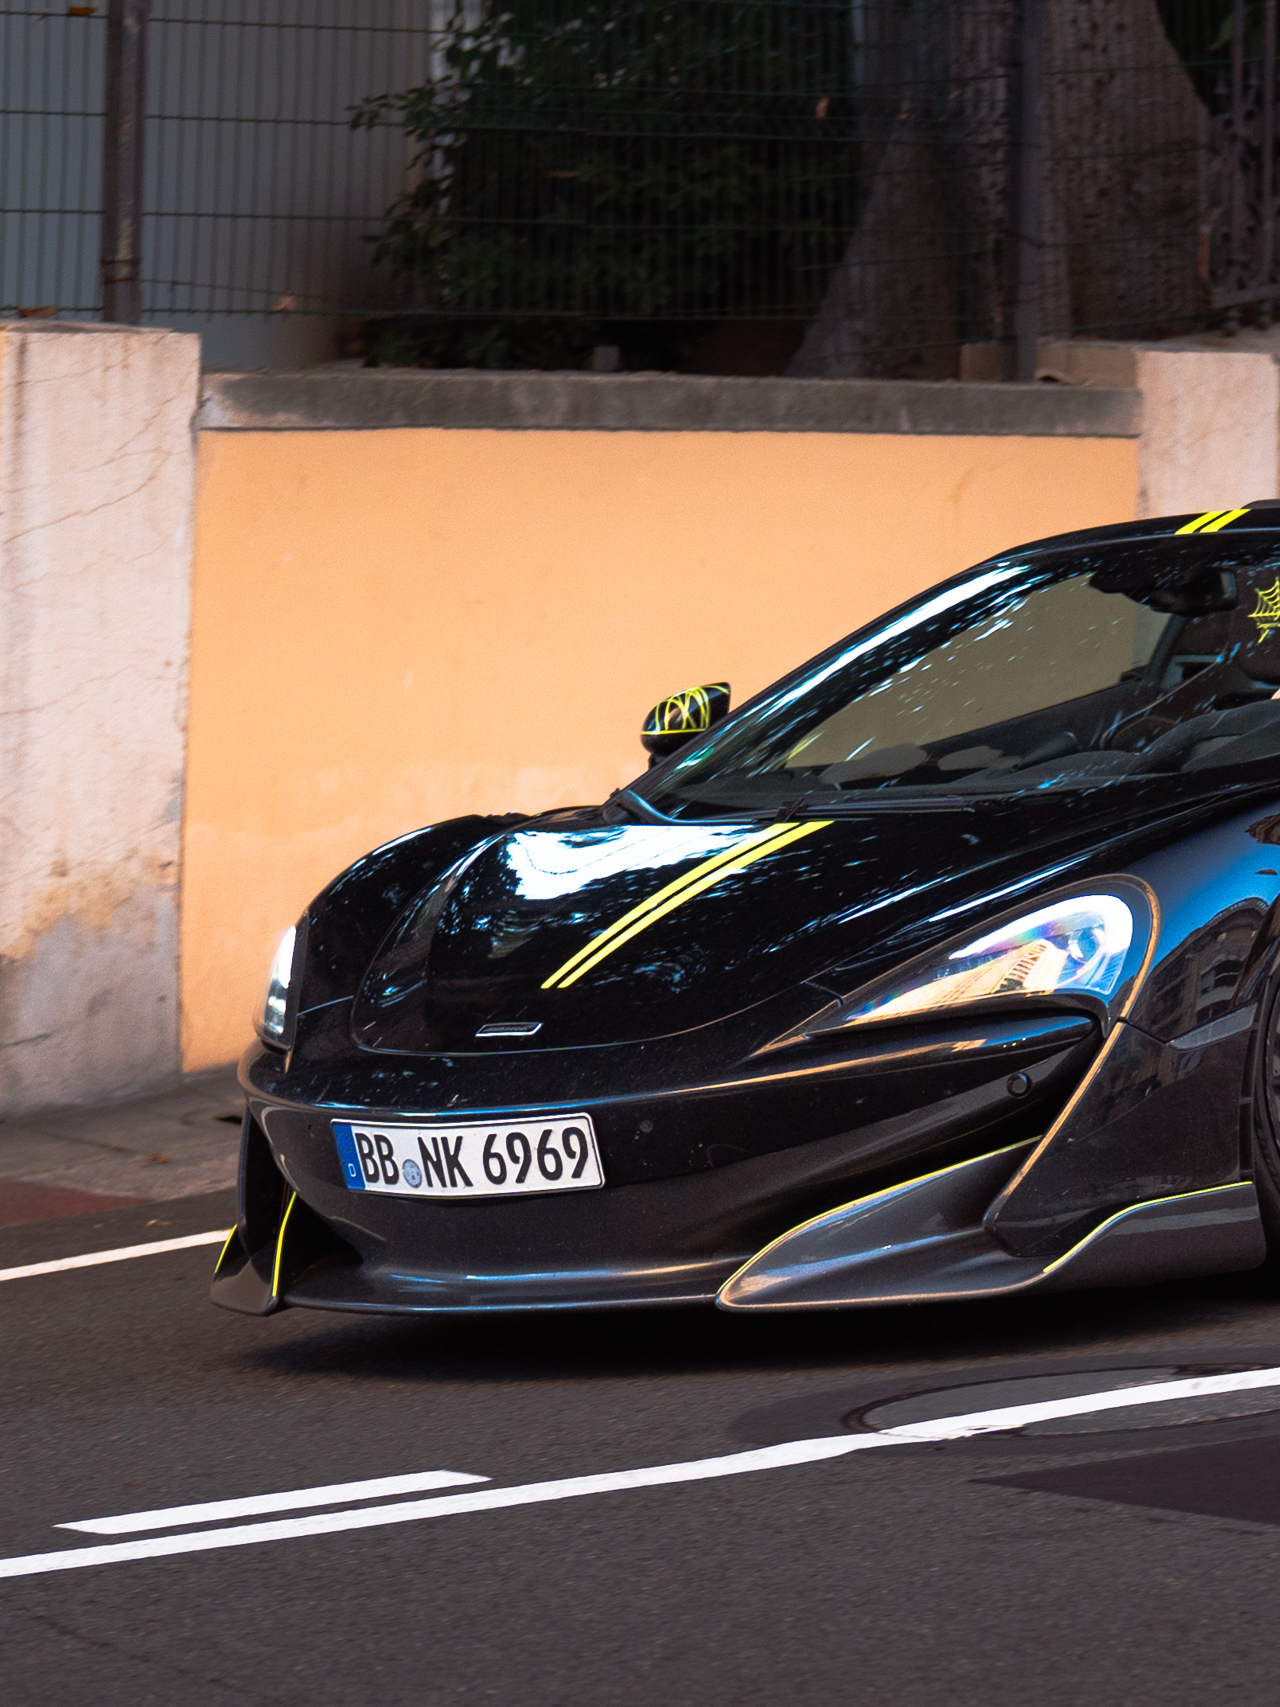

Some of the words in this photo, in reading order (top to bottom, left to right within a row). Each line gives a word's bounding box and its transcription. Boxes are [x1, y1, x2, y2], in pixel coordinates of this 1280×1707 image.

[355, 1132, 399, 1185] BB
[418, 1136, 473, 1187] NK
[482, 1127, 588, 1185] 6969
